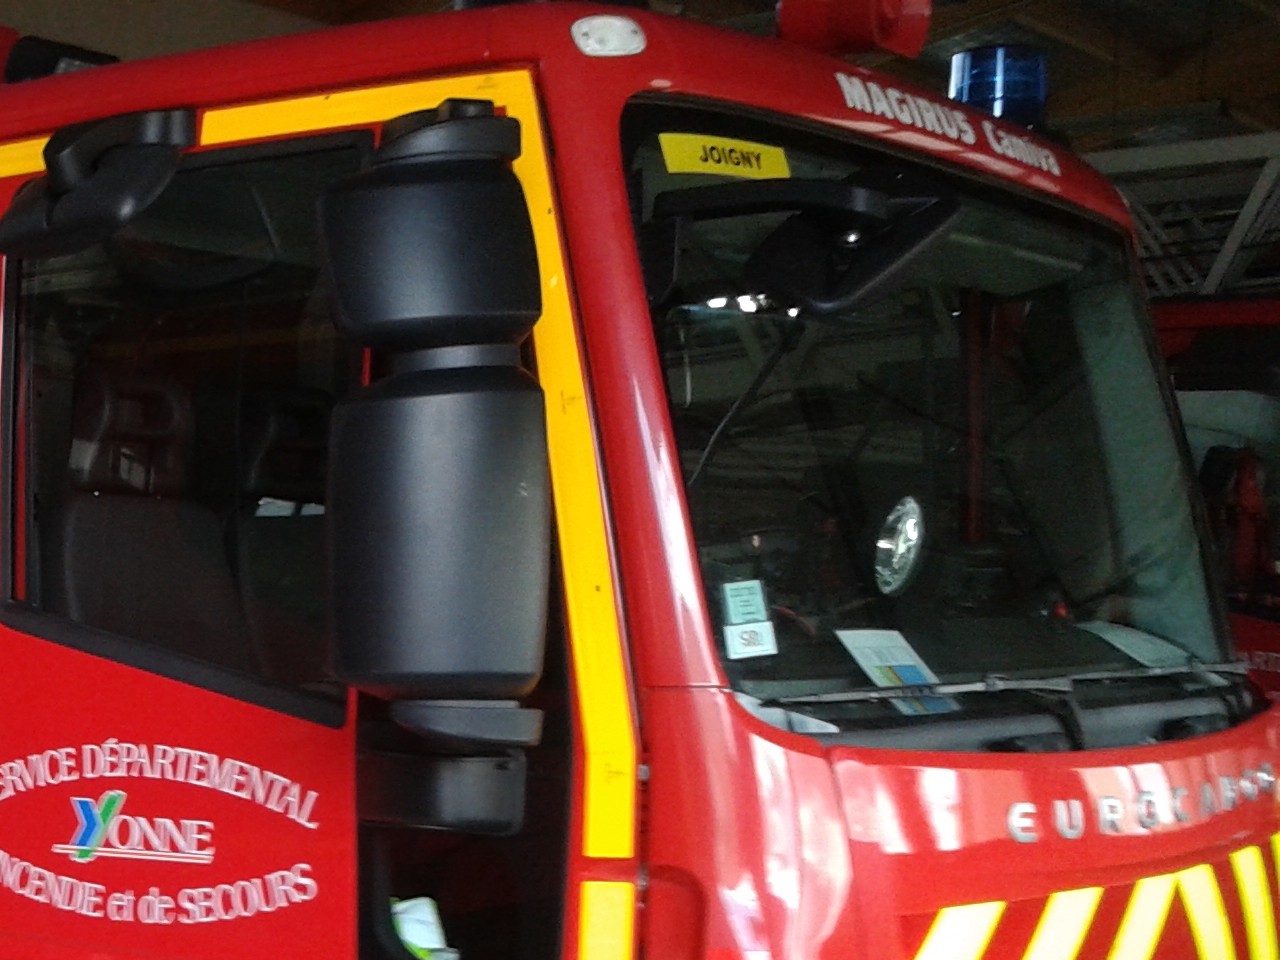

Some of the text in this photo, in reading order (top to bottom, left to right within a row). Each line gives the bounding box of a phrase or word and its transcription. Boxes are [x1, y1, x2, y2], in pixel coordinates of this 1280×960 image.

[834, 72, 976, 145] MAGIRUS
[699, 144, 762, 170] JOIGNY
[81, 738, 320, 829] DÉPARTEMENTAL
[70, 790, 214, 863] YONNE
[107, 889, 136, 922] et
[138, 886, 176, 924] de
[177, 863, 318, 924] SECOURS
